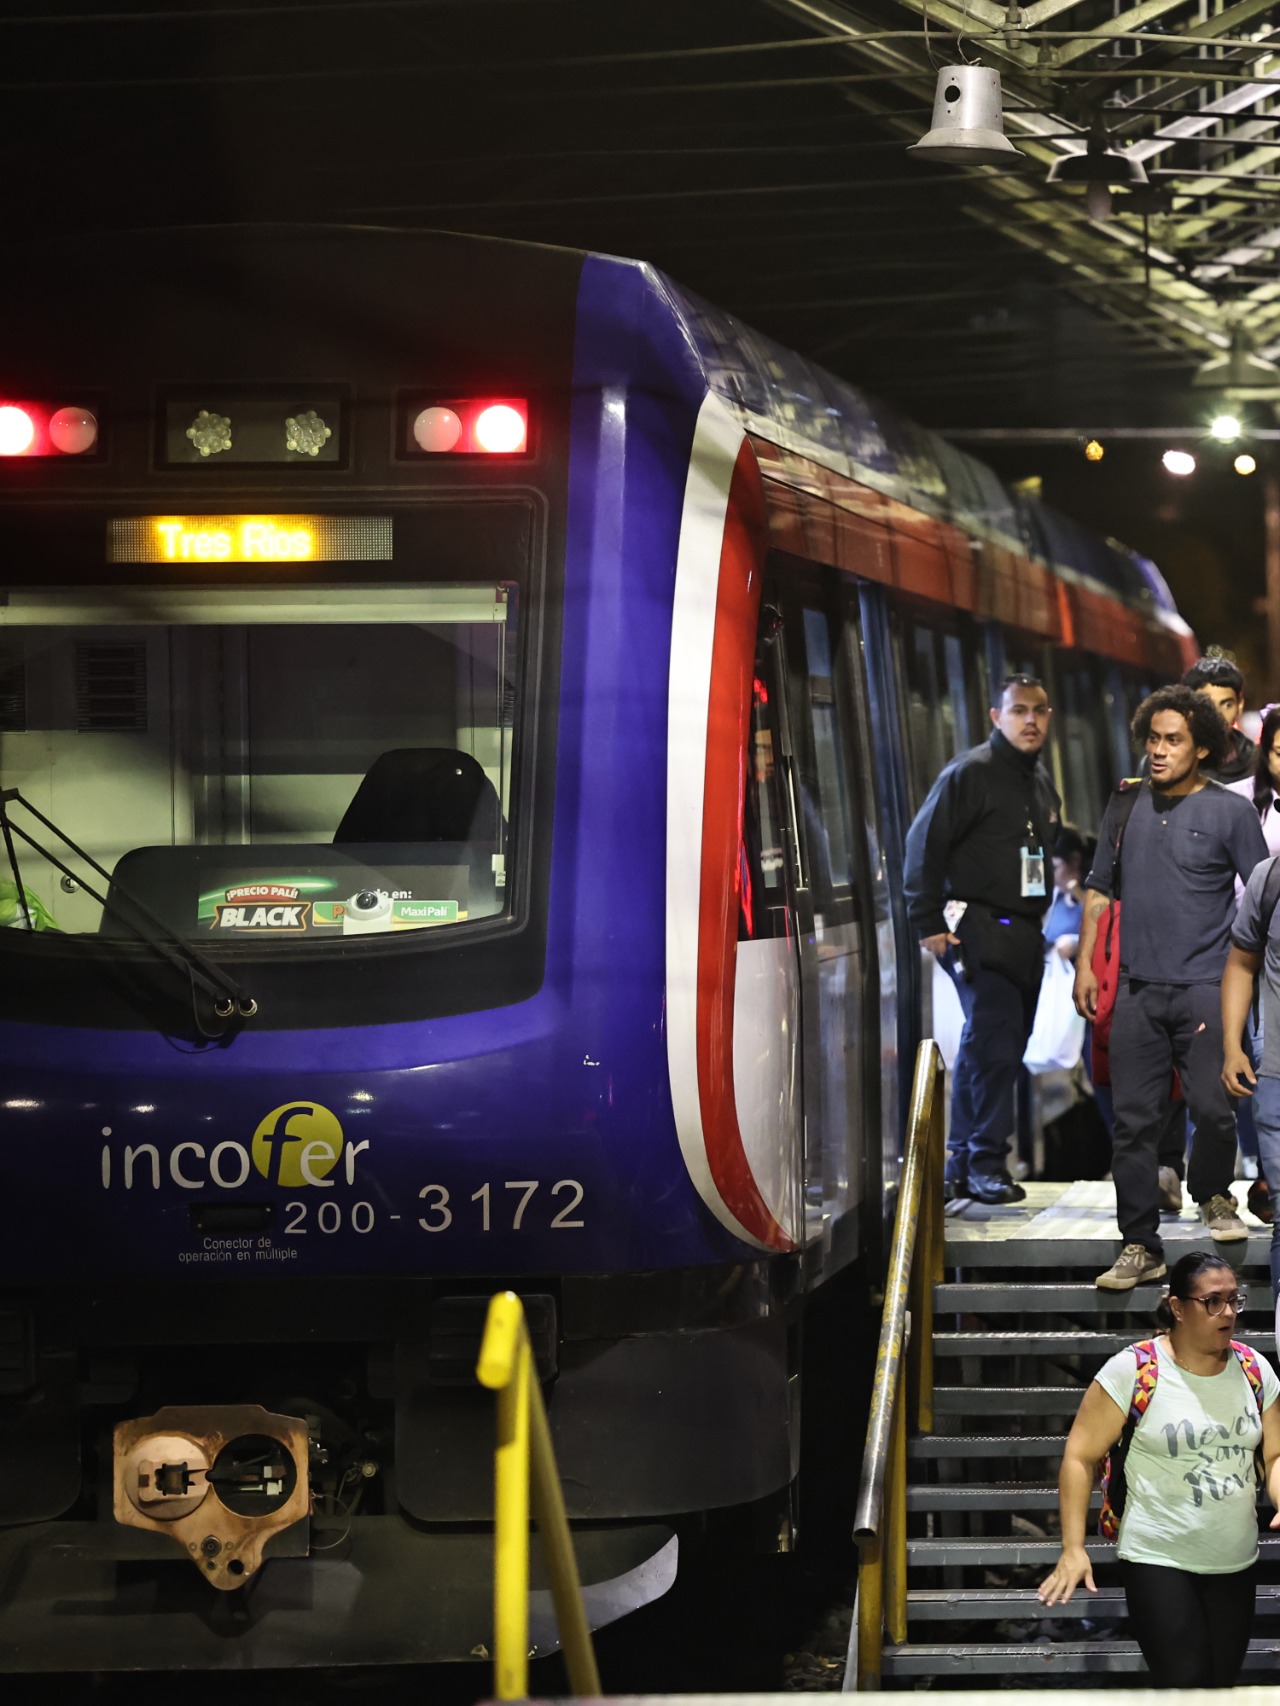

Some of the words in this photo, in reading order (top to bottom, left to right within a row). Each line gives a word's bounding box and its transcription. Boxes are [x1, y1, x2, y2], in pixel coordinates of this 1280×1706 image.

[157, 522, 231, 558] Tres
[220, 906, 302, 927] BLACK
[101, 1105, 370, 1190] incofer
[203, 1237, 253, 1250] Conector
[257, 1237, 272, 1248] de
[178, 1250, 232, 1264] operación
[236, 1251, 250, 1261] en
[255, 1247, 298, 1262] múltiple
